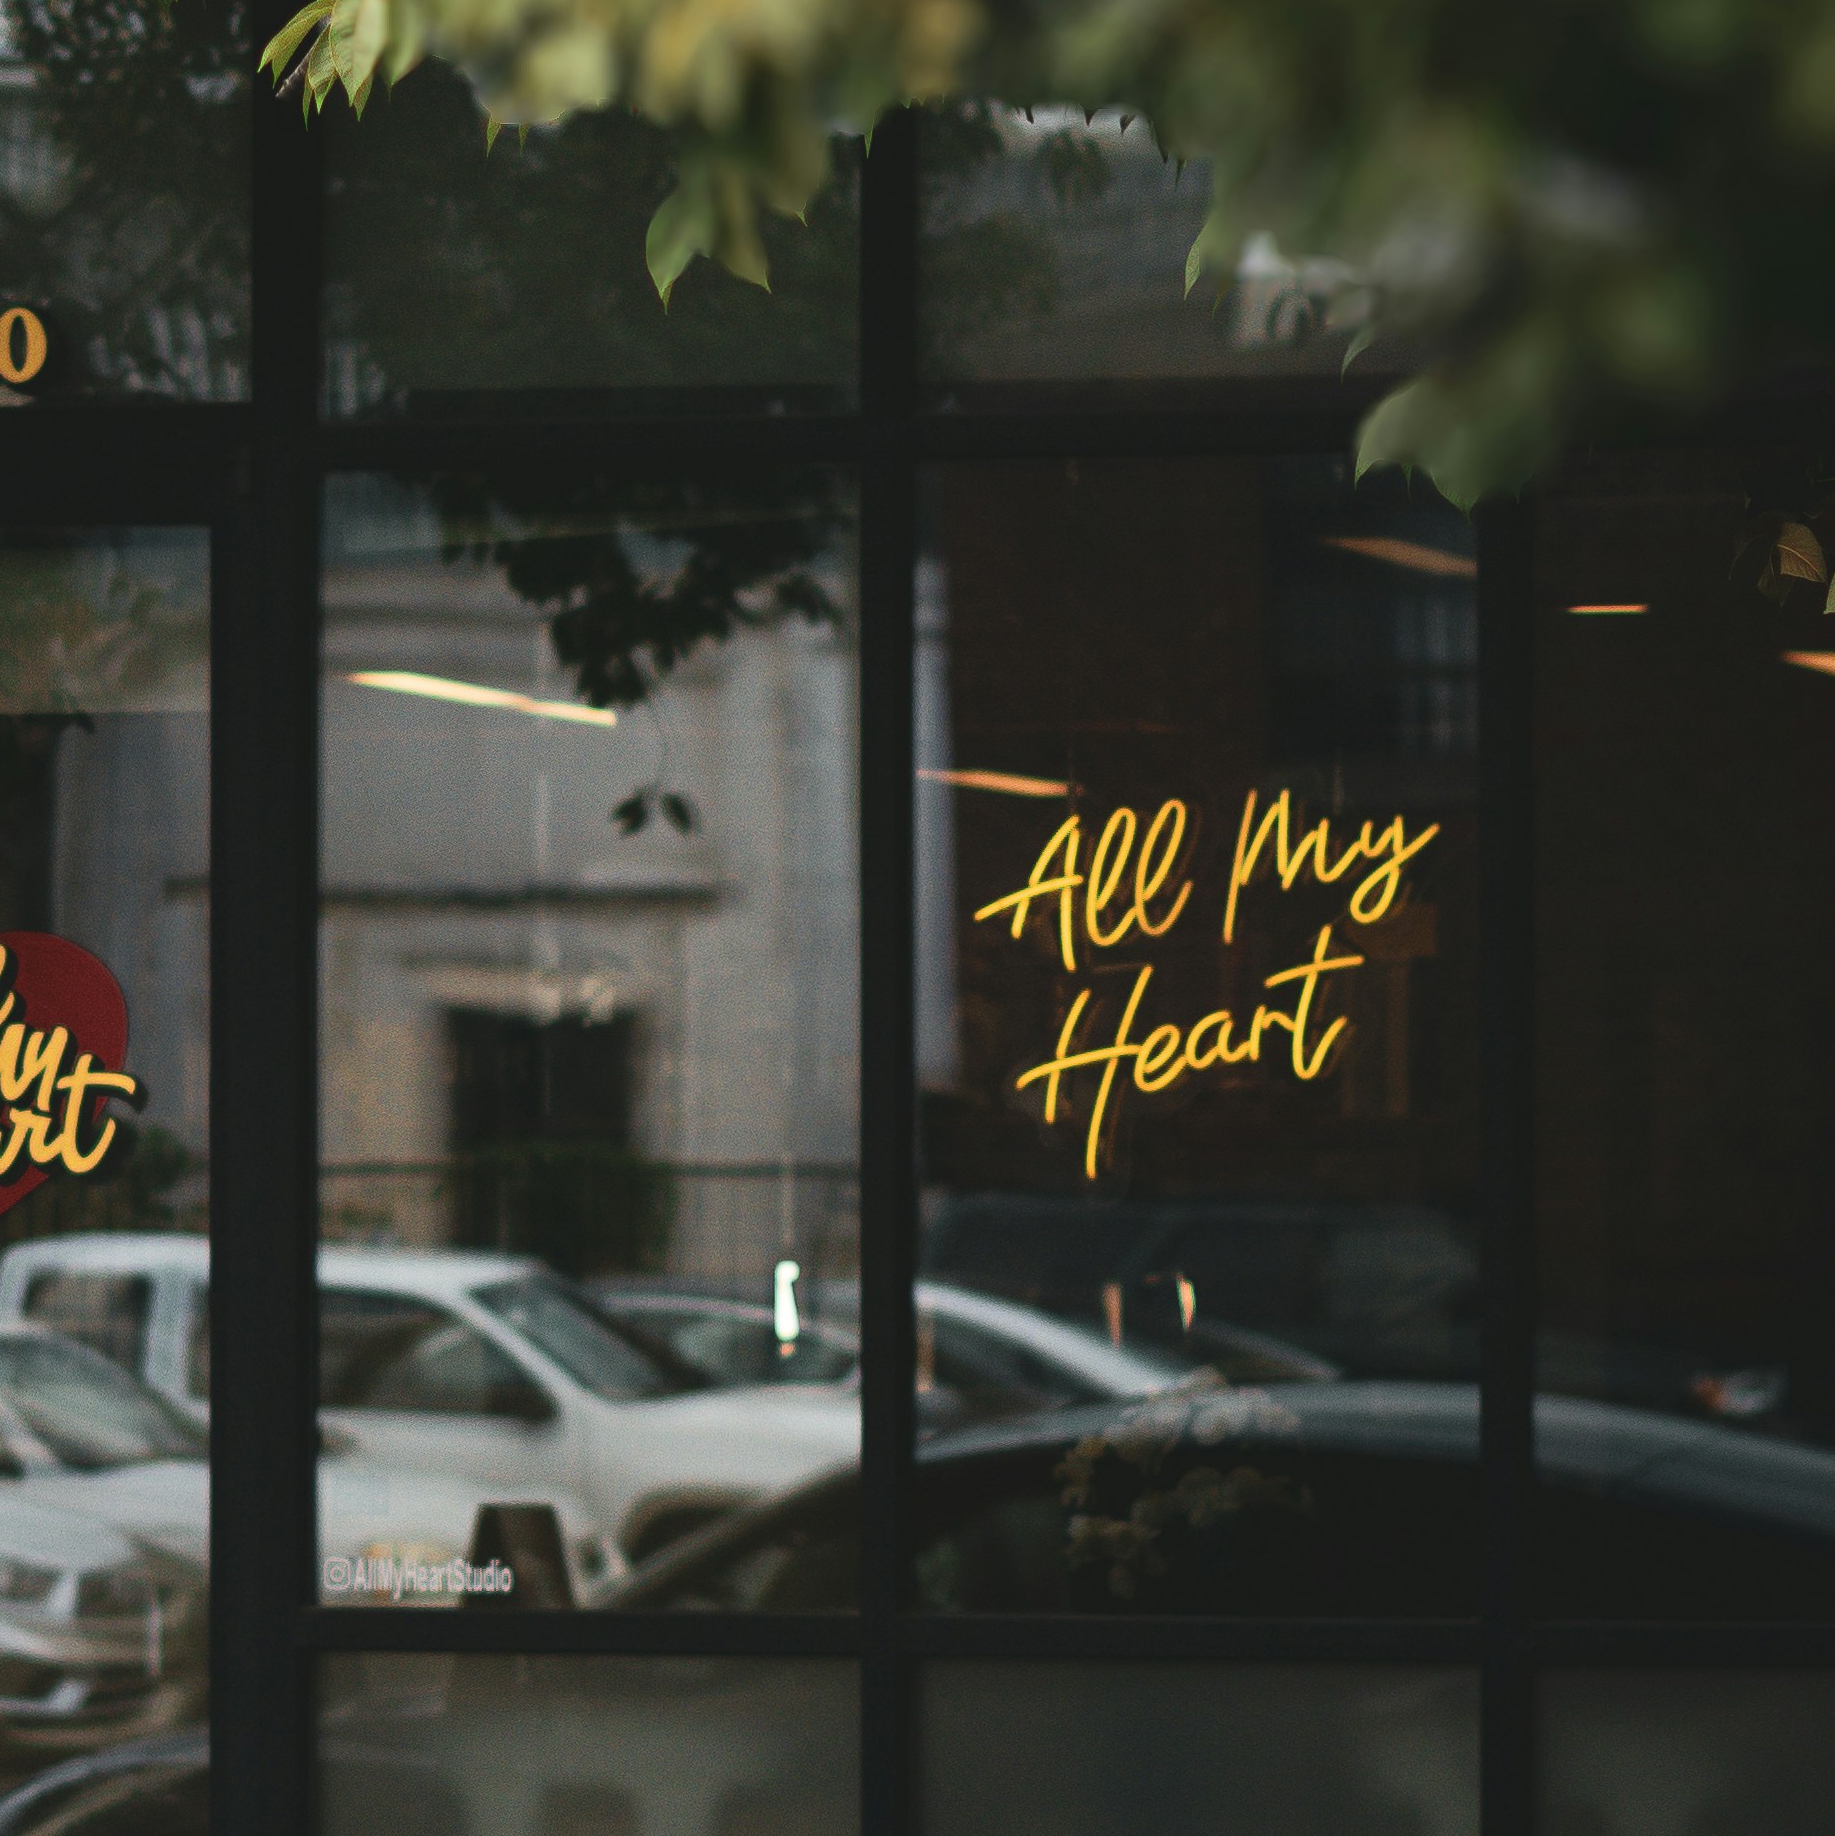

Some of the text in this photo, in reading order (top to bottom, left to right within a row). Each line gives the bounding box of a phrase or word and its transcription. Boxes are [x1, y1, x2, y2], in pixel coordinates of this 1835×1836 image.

[973, 788, 1441, 972] All My
[1014, 924, 1365, 1180] Heart
